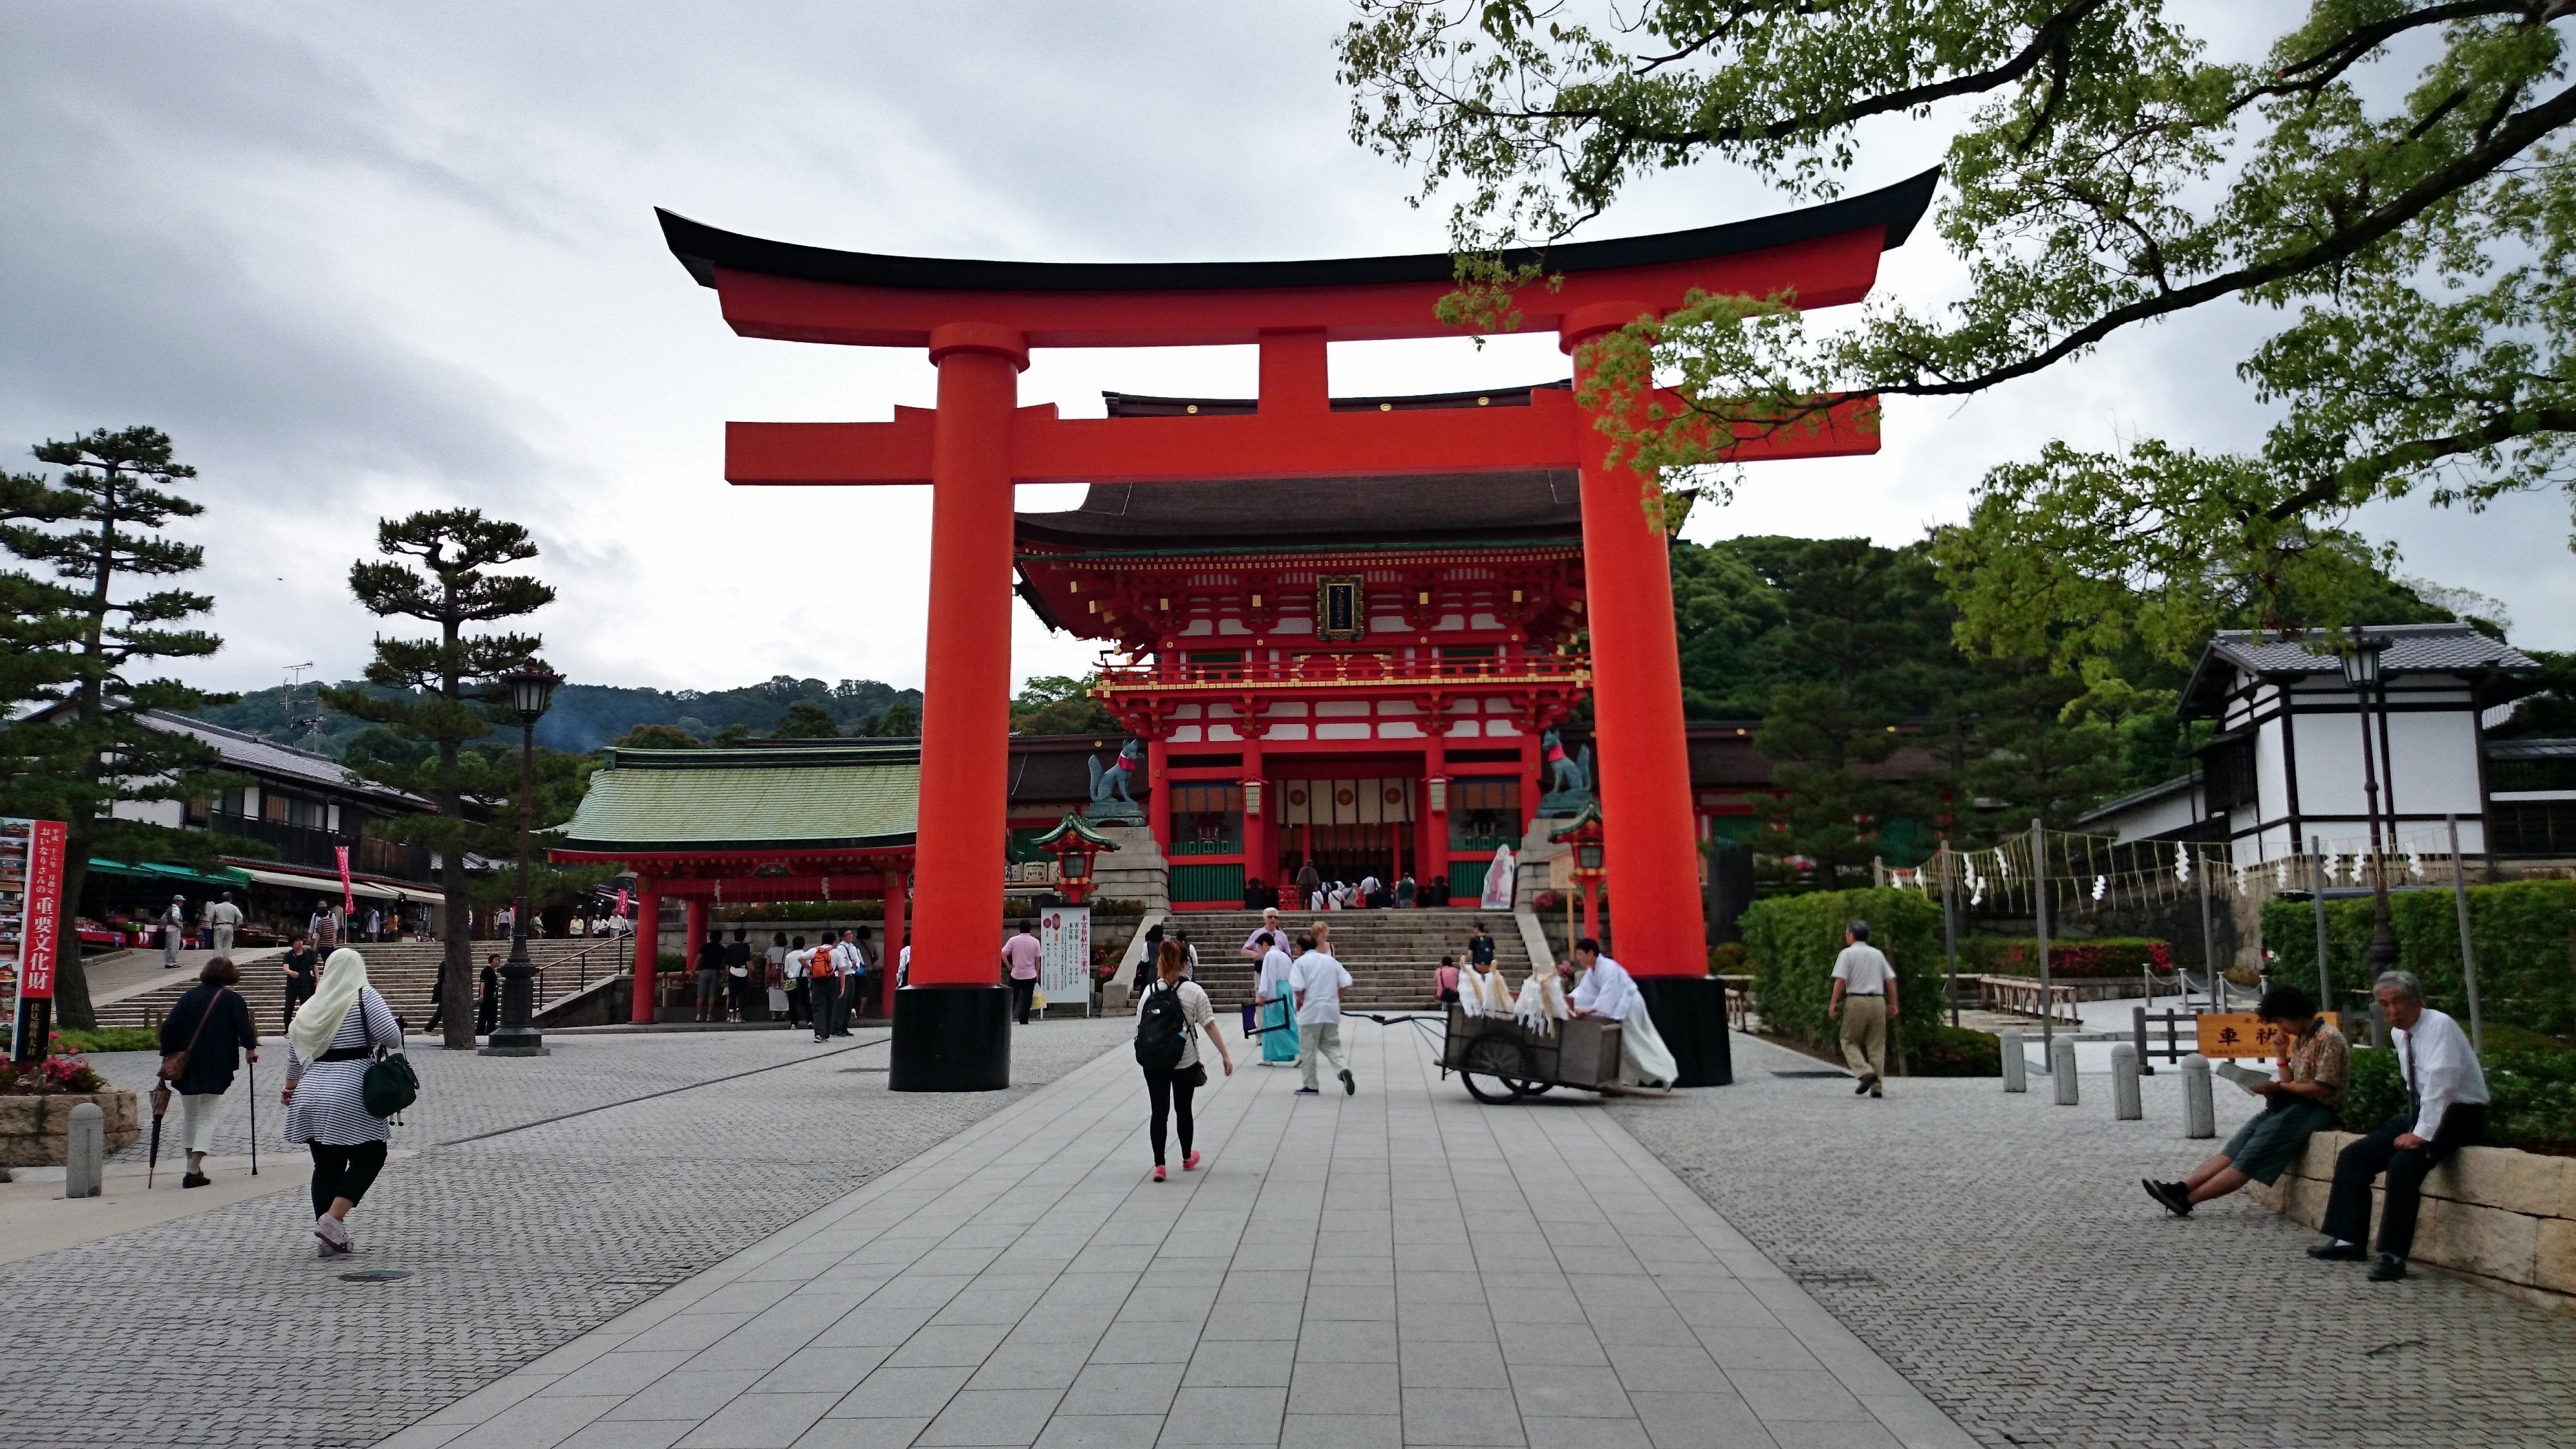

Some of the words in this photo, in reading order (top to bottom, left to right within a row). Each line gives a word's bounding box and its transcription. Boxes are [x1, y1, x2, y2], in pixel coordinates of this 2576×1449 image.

[36, 827, 50, 893] おいなりさんの
[28, 897, 54, 990] 重要文化財
